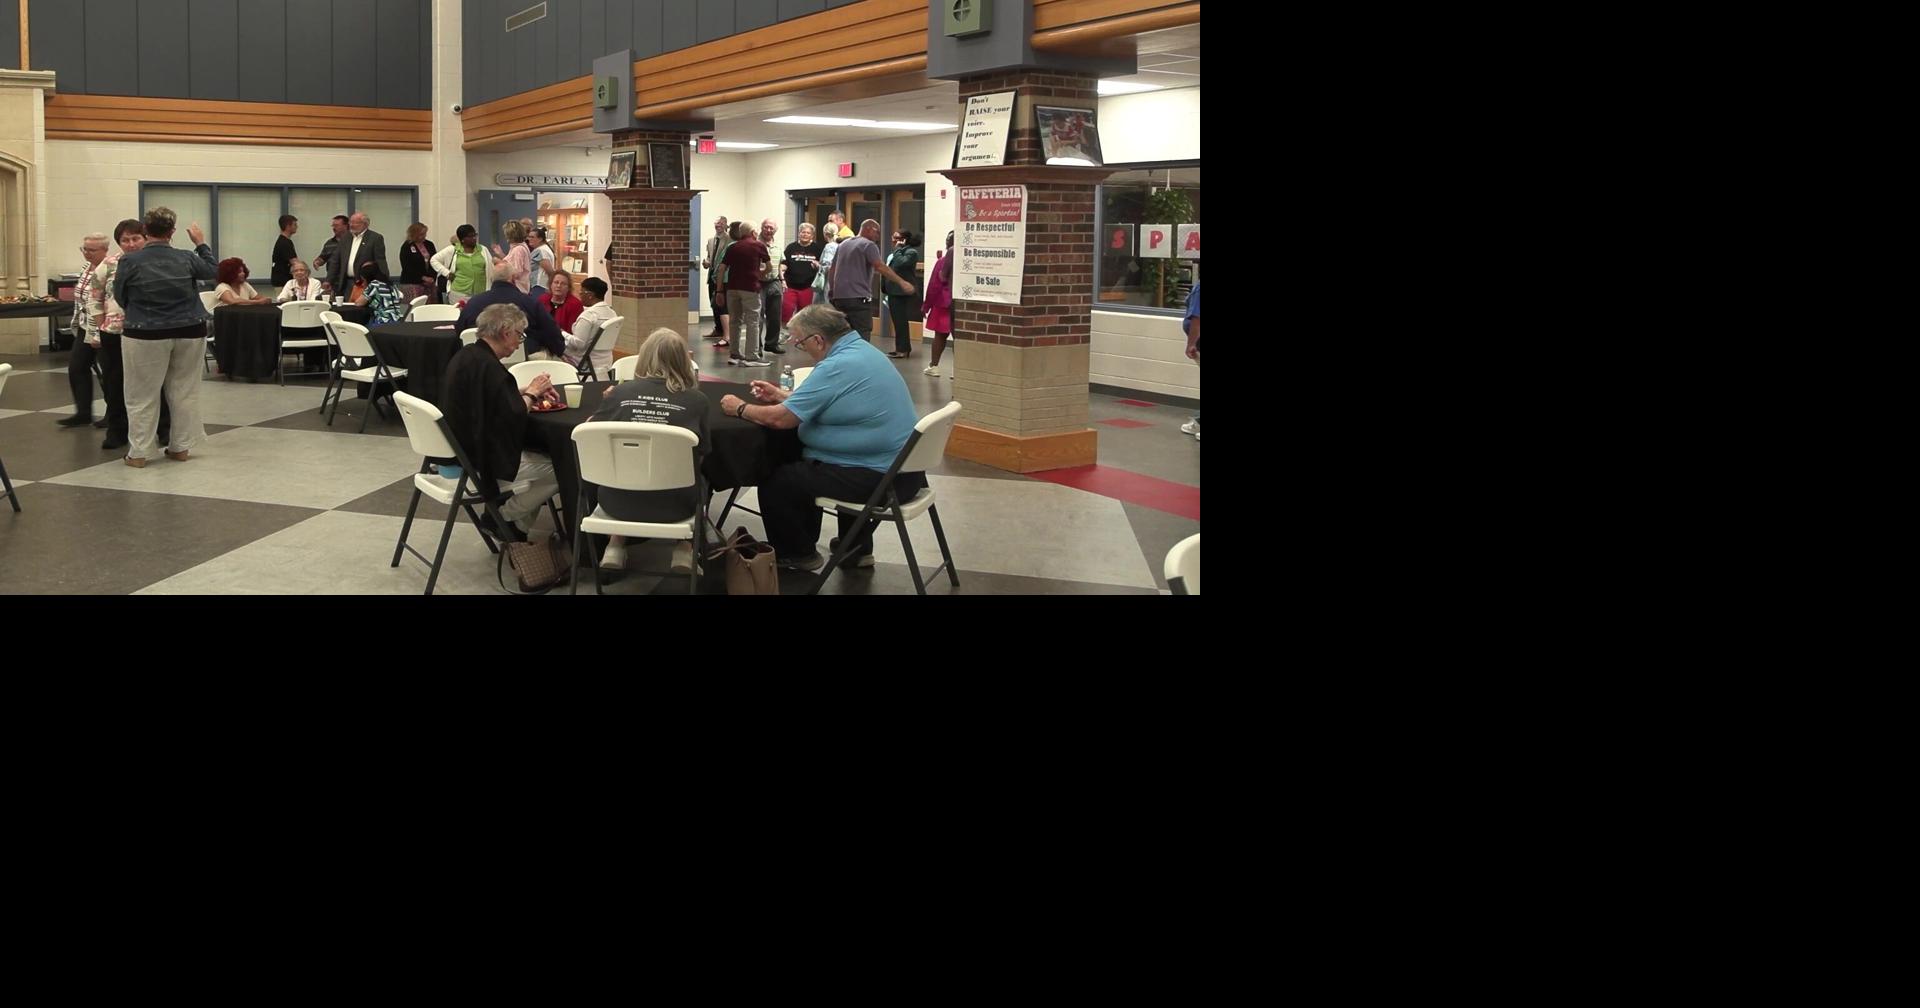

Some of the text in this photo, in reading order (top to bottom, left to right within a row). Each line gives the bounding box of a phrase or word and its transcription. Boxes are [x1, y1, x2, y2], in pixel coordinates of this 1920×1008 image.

[971, 96, 989, 105] Don't
[969, 106, 1010, 116] RAISE your
[965, 131, 993, 139] Improve
[963, 143, 979, 151] your
[517, 176, 538, 184] DR.
[543, 176, 577, 185] EARL
[582, 177, 593, 185] A.
[961, 187, 1022, 199] CAFETERIA
[965, 222, 1015, 232] Be Respectful
[963, 247, 1016, 259] Be Responsible
[975, 275, 1000, 286] Be Safe
